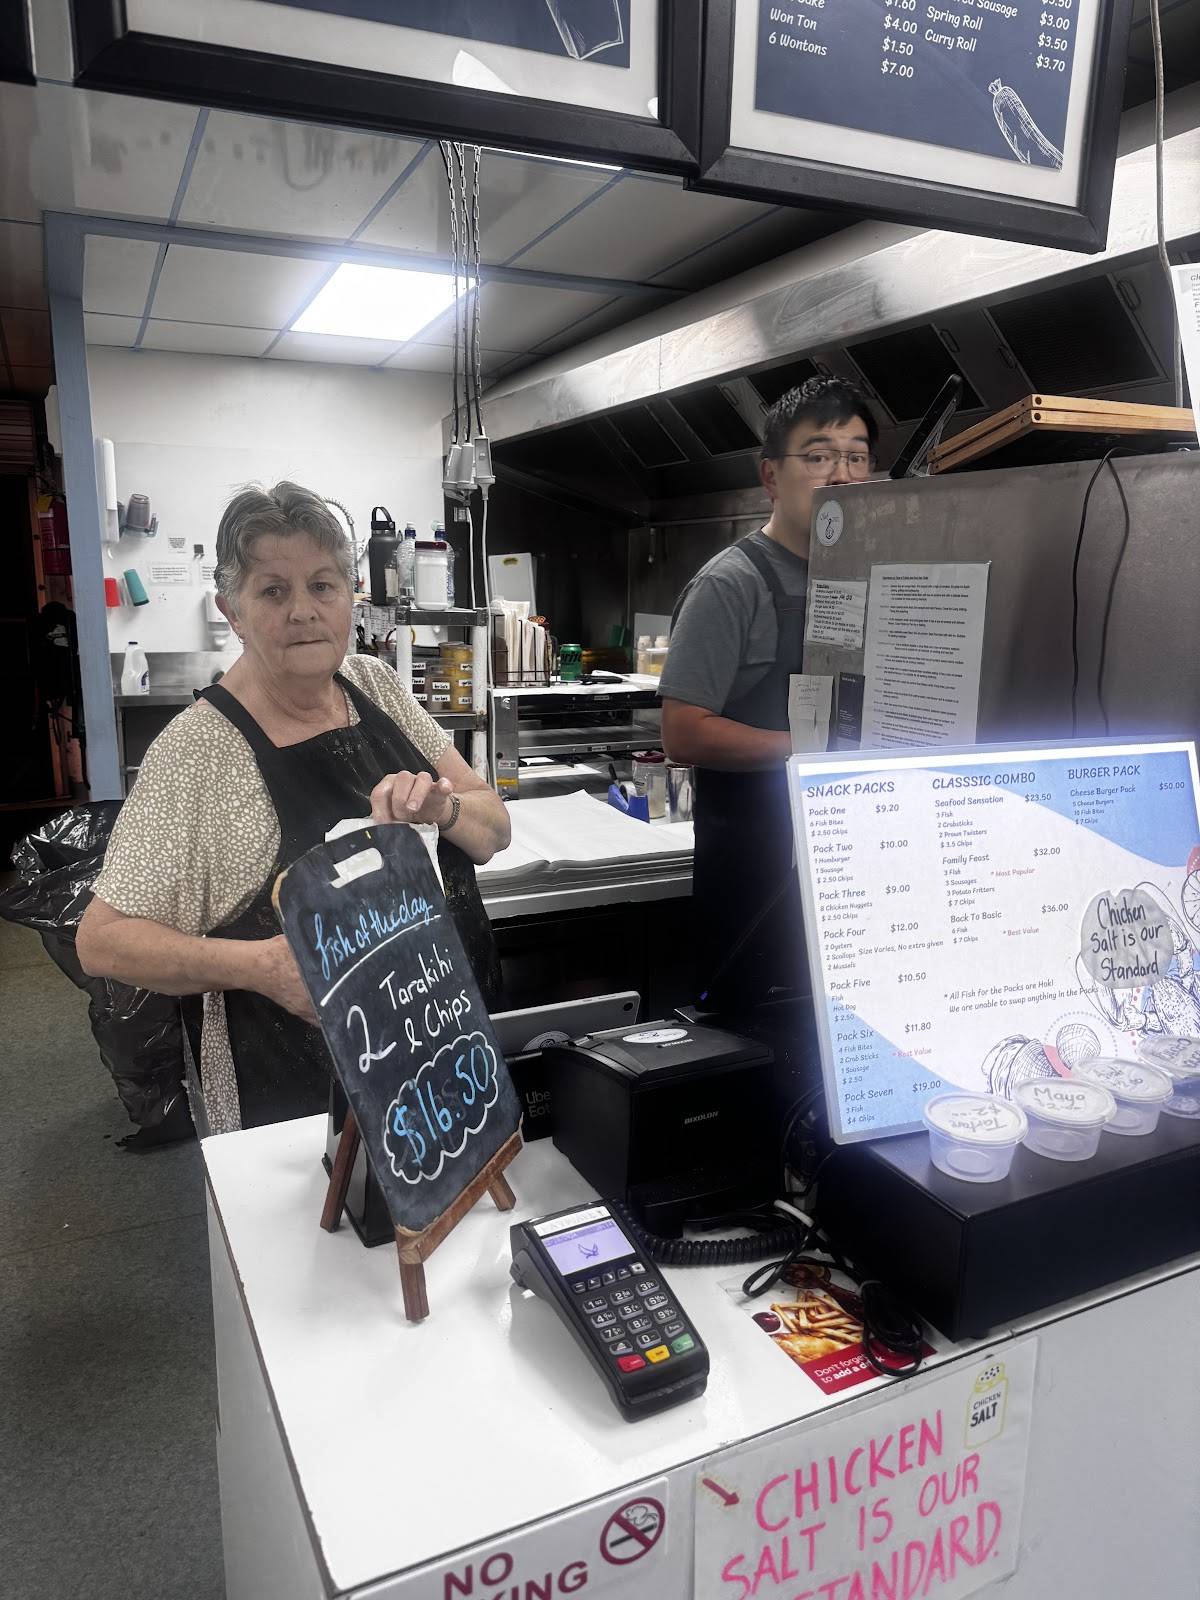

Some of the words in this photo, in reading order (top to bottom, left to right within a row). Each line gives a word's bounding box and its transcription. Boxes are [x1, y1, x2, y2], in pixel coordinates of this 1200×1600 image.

[770, 7, 794, 25] Won
[797, 14, 817, 30] Ton
[926, 6, 961, 28] Spring
[962, 15, 984, 31] Roll
[976, 0, 1018, 18] Sausage
[883, 14, 918, 34] $4.00
[1040, 11, 1070, 31] $3.00
[768, 32, 776, 44] 6
[780, 34, 828, 56] Wontons
[882, 36, 914, 56] $1.50
[925, 29, 955, 49] Curry
[956, 36, 977, 52] Roll
[1037, 32, 1068, 51] $3.50
[880, 58, 914, 78] $7.00
[1035, 53, 1066, 72] $3.70
[932, 775, 991, 790] CLASSSIC
[994, 772, 1035, 785] COMBO
[1068, 767, 1110, 780] BURGER
[1113, 765, 1141, 776] PACK
[807, 784, 851, 798] SNACK
[854, 781, 895, 794] PACKS
[1070, 789, 1095, 797] Cheese
[1096, 787, 1118, 796] Burger
[1120, 784, 1136, 793] Pack
[1159, 782, 1185, 791] $50.00
[809, 806, 829, 816] Pack
[830, 807, 846, 815] One
[875, 804, 899, 813] $9.20
[935, 797, 966, 807] Seafood
[967, 795, 1004, 805] Sensation
[1024, 793, 1052, 803] $23.50
[813, 843, 834, 853] Pack
[836, 843, 853, 852] Two
[880, 840, 908, 850] $10.00
[942, 855, 967, 865] Family
[969, 854, 990, 862] Feast
[1033, 847, 1061, 857] $32.00
[819, 890, 839, 900] Pack
[842, 888, 866, 898] Three
[885, 884, 910, 894] $9.00
[951, 913, 969, 923] Back
[970, 913, 980, 921] To
[981, 911, 1002, 920] Basic
[1041, 903, 1069, 914] $36.00
[1097, 896, 1146, 930] Chicken
[313, 913, 356, 981] fish
[398, 890, 434, 922] day
[824, 928, 845, 939] Pack
[846, 927, 866, 937] Four
[890, 922, 919, 933] $12.00
[1090, 929, 1118, 953] Salt
[1122, 928, 1136, 947] is
[1141, 924, 1164, 941] our
[858, 947, 873, 955] Size
[1100, 950, 1159, 982] Standard
[379, 943, 453, 1010] Tarakihi
[830, 979, 851, 991] Pack
[853, 978, 871, 988] Five
[897, 972, 927, 983] $10.50
[949, 1003, 960, 1013] We
[961, 1003, 973, 1011] are
[974, 1000, 998, 1010] unable
[999, 998, 1008, 1006] to
[1009, 996, 1026, 1006] swap
[1027, 991, 1057, 1004] anything
[1058, 990, 1065, 998] in
[1066, 988, 1078, 997] the
[1079, 985, 1099, 995] Packs
[950, 992, 960, 1000] All
[961, 989, 976, 999] Fish
[977, 988, 988, 997] for
[990, 985, 1002, 995] the
[1003, 983, 1024, 993] Packs
[1025, 982, 1037, 990] are
[424, 988, 472, 1038] Chips
[347, 1004, 397, 1073] 2
[837, 1030, 858, 1043] Pack
[860, 1029, 874, 1039] Six
[904, 1021, 931, 1033] $11.80
[525, 1090, 552, 1104] Ube
[844, 1090, 867, 1102] Pack
[868, 1088, 893, 1099] Seven
[912, 1080, 941, 1093] $19.00
[1034, 1087, 1086, 1106] Mayo
[392, 1044, 490, 1166] $16.50
[684, 1110, 720, 1125] BIXOLON
[814, 1363, 841, 1377] Don't
[821, 1375, 832, 1383] to
[833, 1367, 852, 1380] add
[973, 1391, 1001, 1410] CHICKEN
[970, 1401, 998, 1427] SALT
[755, 1409, 944, 1532] CHICKEN
[721, 1521, 827, 1600] SALT
[857, 1497, 894, 1551] IS
[918, 1453, 981, 1518] OUR
[444, 1552, 514, 1600] NO
